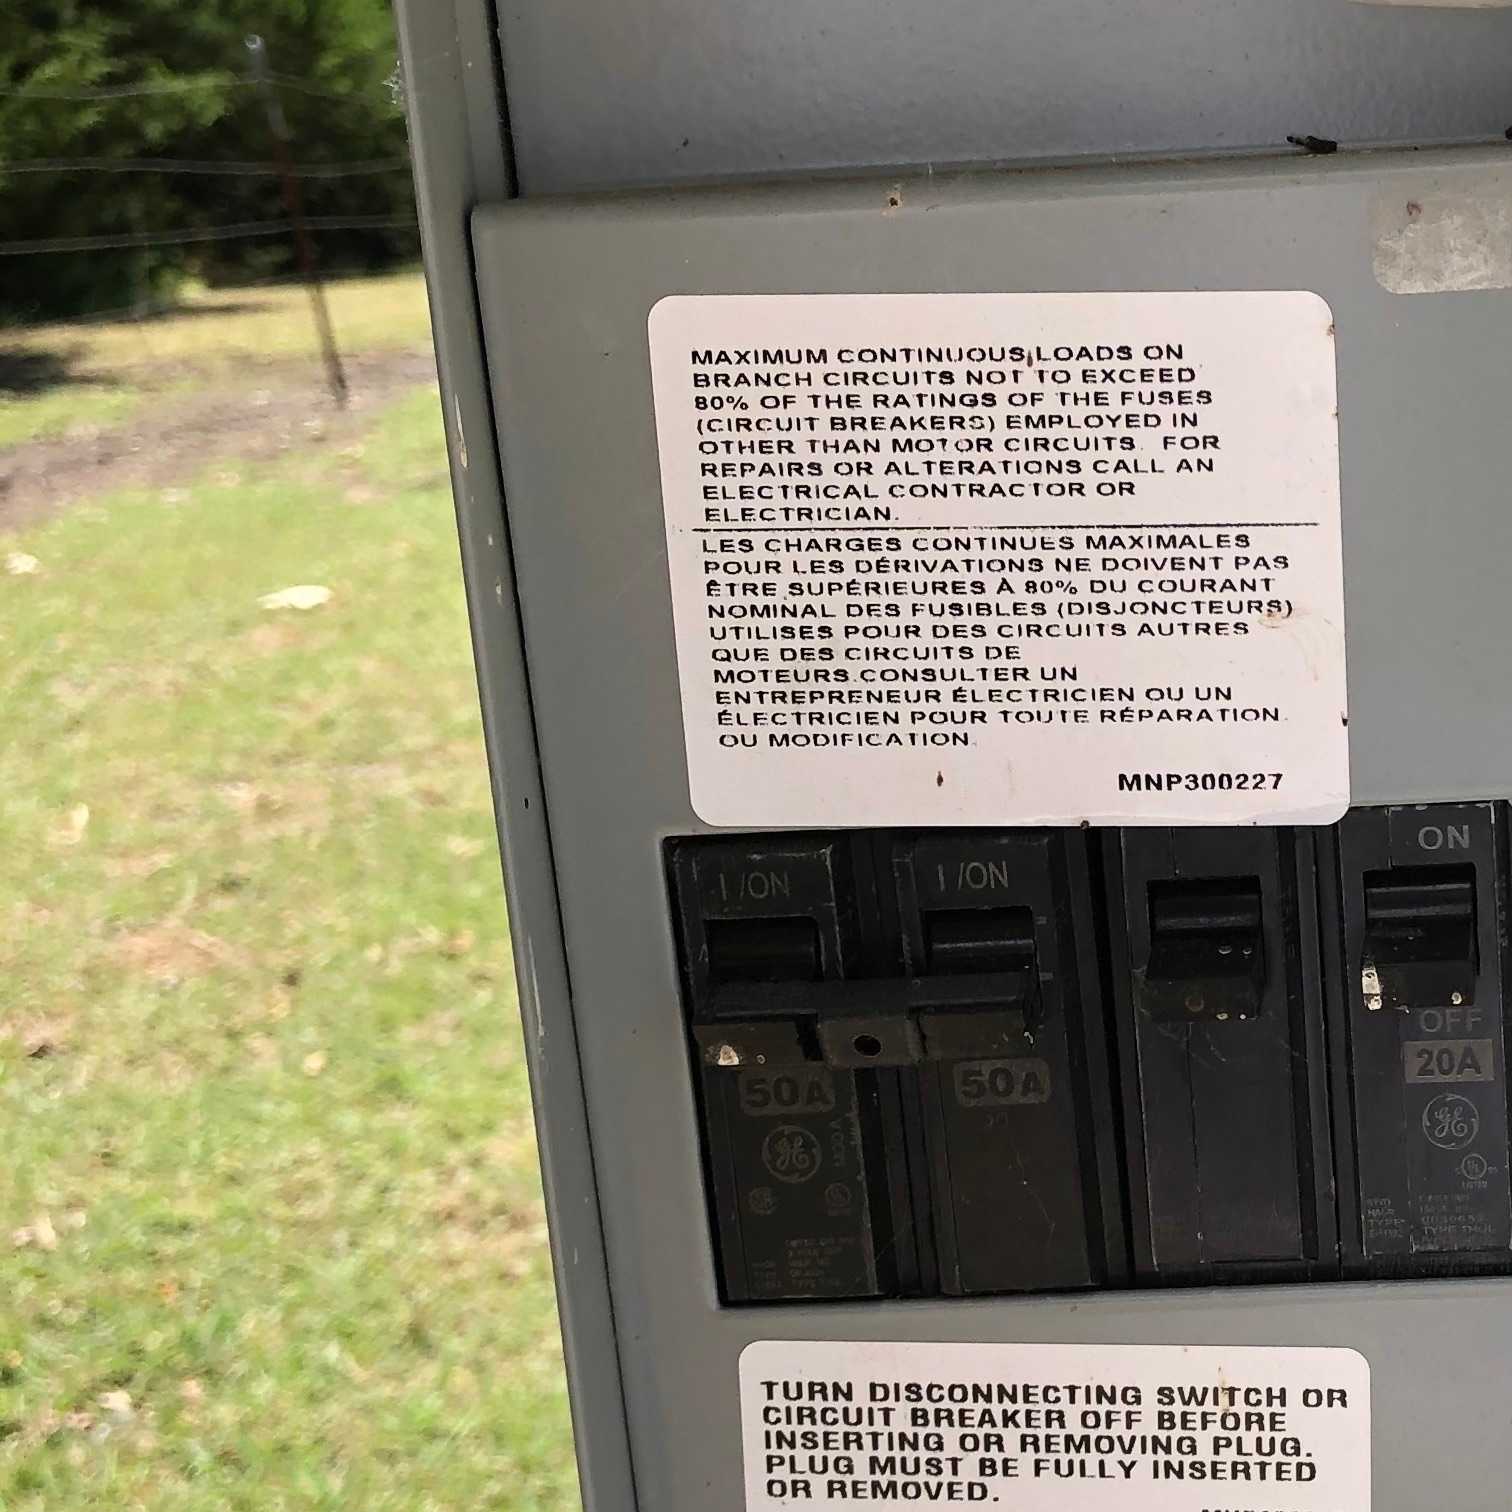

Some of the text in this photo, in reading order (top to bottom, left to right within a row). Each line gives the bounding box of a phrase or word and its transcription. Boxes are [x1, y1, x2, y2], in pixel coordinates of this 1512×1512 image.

[692, 344, 1183, 365] MAXIMUM CONTINUOUS LOADS ON
[693, 368, 1195, 389] BRANCH CIRCUITS NOT TO EXCEED
[695, 390, 1212, 410] 80% OF THE RATINGS OF THE FUSES
[697, 412, 1197, 435] (CIRCUIT BREAKERS) EMPLOYED IN
[699, 440, 796, 455] OTHER
[805, 438, 880, 454] THAN
[892, 438, 993, 453] MOTOR
[1163, 435, 1221, 450] FOR
[701, 458, 1213, 478] REPAIRS OR ALTERATIONS CALL AN
[703, 481, 1135, 501] ELECTRICAL CONTRACTOR OR
[705, 506, 899, 523] ELECTRICIAN.
[703, 534, 1250, 554] LES CHARGES CONTINUES MAXIMALES
[704, 556, 1288, 575] POUR LES DÉRIVATIONS NE DOIVENT PAS
[706, 577, 1275, 597] ÊTRE SUPÉRIEURES À 80% DU COURANT
[708, 600, 1292, 619] NOMINAL DES FUSIBLES (DISJONCTEURS)
[710, 622, 1249, 640] UTILISES POUR DES CIRCUITS AUTRES
[712, 645, 1021, 663] QUE DES CIRCUITS DE
[1041, 666, 1077, 681] UN
[716, 686, 1231, 705] ENTREPRENEUR ÉLECTRICIEN OU UN
[718, 709, 899, 726] ÉLECTRICIEN
[911, 710, 987, 725] POUR
[998, 710, 1089, 724] TOUTE
[719, 734, 757, 747] OU
[1119, 773, 1283, 791] MNP300227
[1418, 825, 1470, 850] ON
[1420, 1008, 1482, 1033] OFF
[1416, 1047, 1482, 1076] 20A
[745, 1074, 831, 1108] 50A
[961, 1065, 1045, 1099] 50A
[760, 1381, 1347, 1408] TURN DISCONNECTING SWITCH OR
[763, 1405, 1286, 1432] CIRCUIT BREAKER OFF BEFORE
[765, 1430, 1312, 1457] INSERTING OR REMOVING PLUG.
[766, 1454, 1316, 1481] PLUG MUST BE FULLY INSERTED
[767, 1479, 999, 1502] OR REMOVED.
